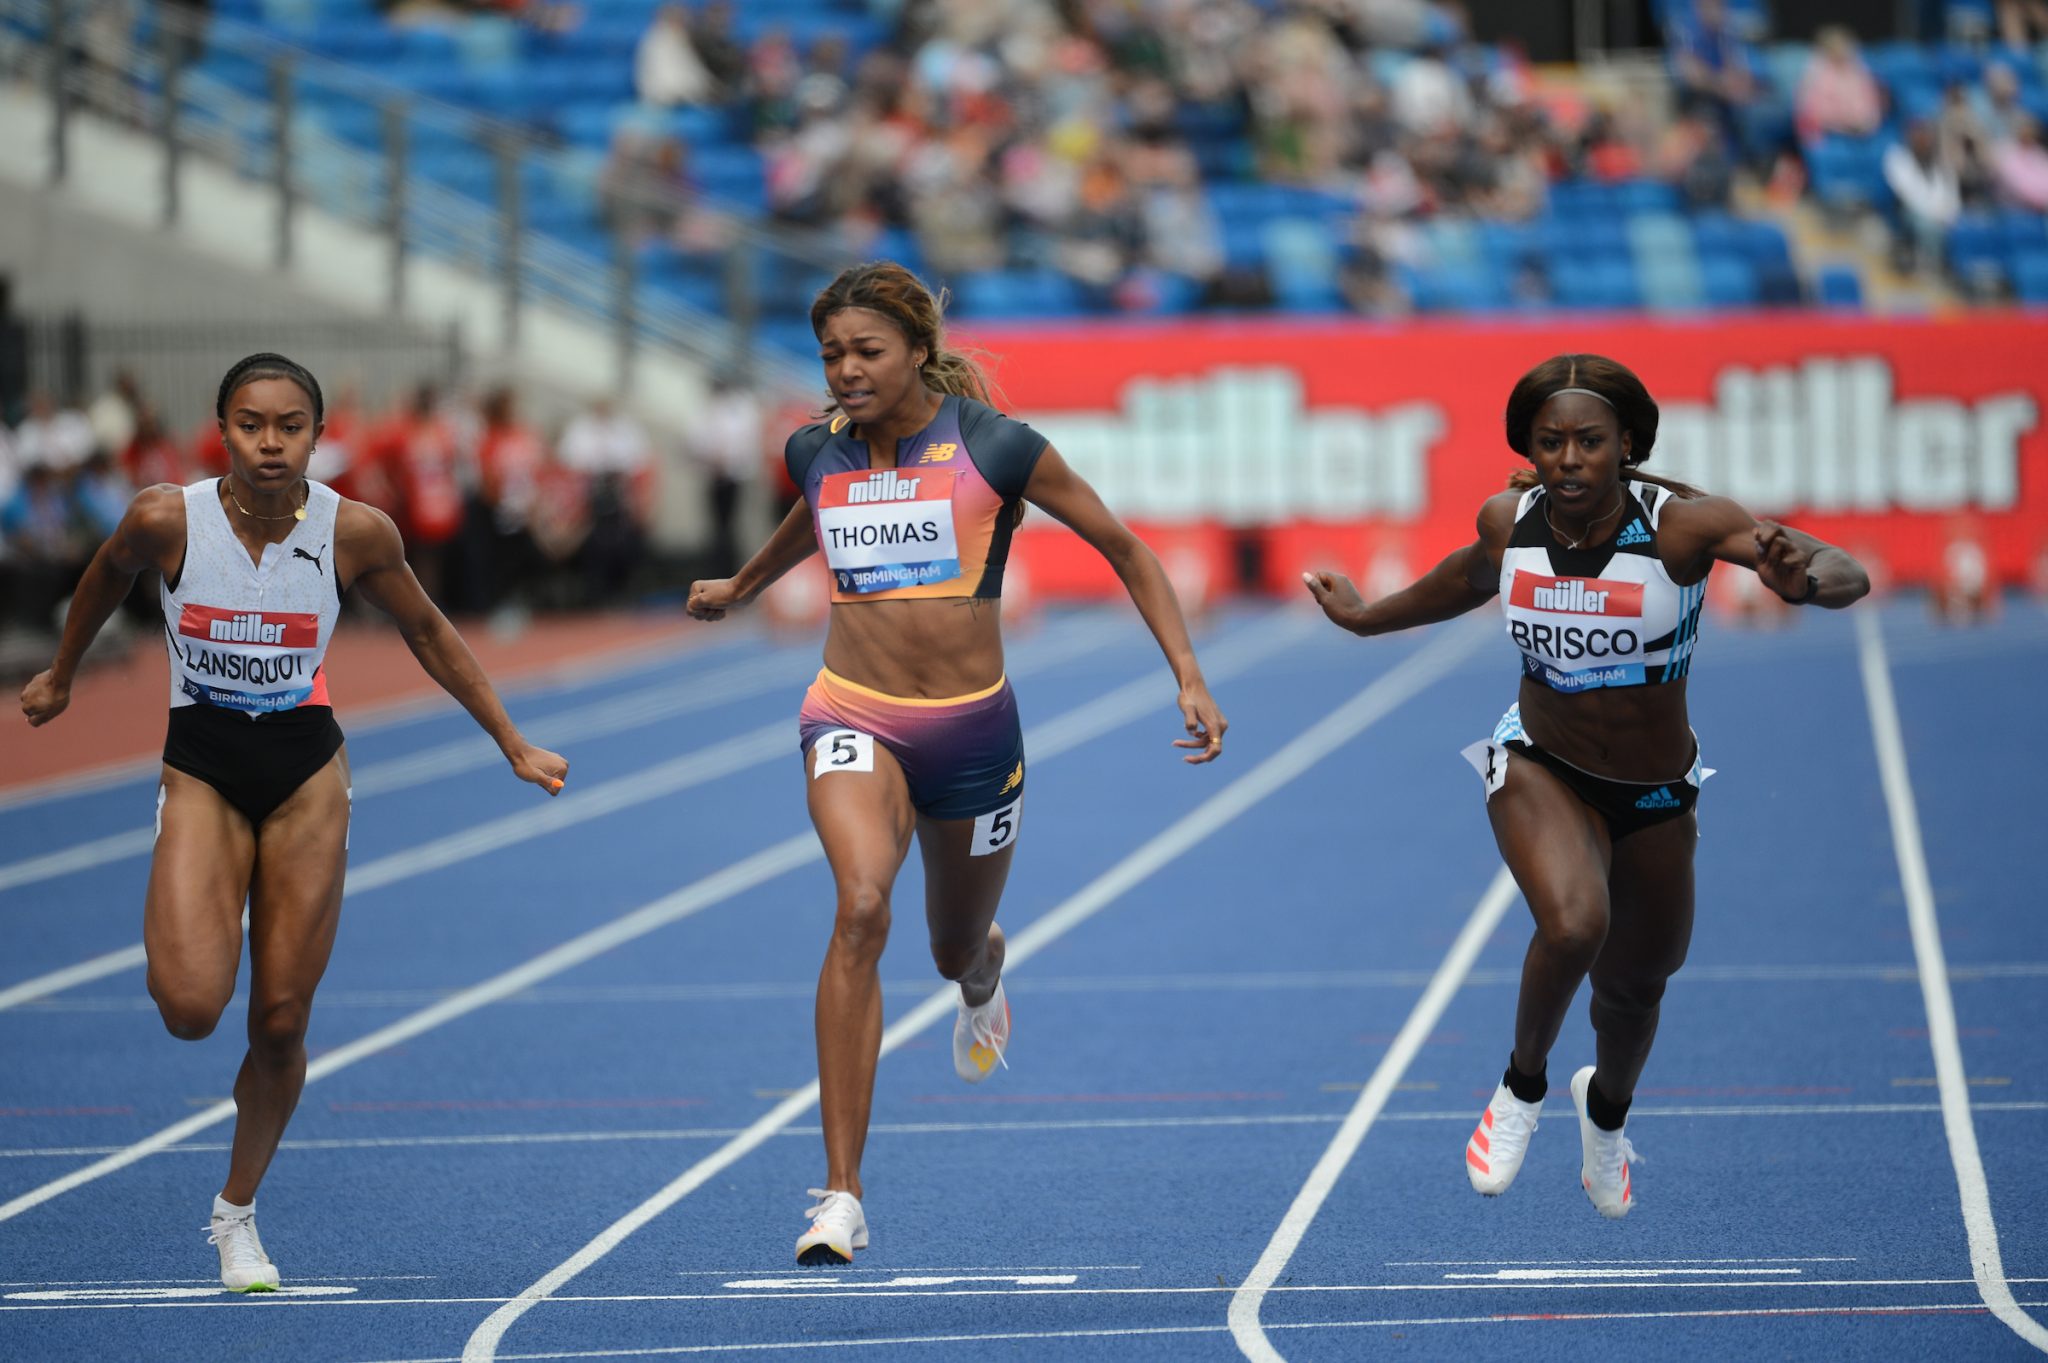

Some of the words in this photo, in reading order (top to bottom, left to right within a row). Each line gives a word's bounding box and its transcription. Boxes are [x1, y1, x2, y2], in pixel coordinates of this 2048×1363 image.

[847, 470, 921, 503] müller
[829, 521, 938, 549] THOMAS
[1616, 533, 1652, 547] adidas
[852, 565, 941, 586] BIRMINGHAM
[1533, 580, 1609, 613] müller
[209, 613, 286, 644] müller
[1511, 619, 1638, 660] BRISCO
[1545, 669, 1626, 687] BIRMINGHAM
[209, 691, 296, 707] BIRMINGHAM
[831, 734, 858, 765] 5
[1635, 799, 1680, 809] adidas
[989, 807, 1013, 847] 5
